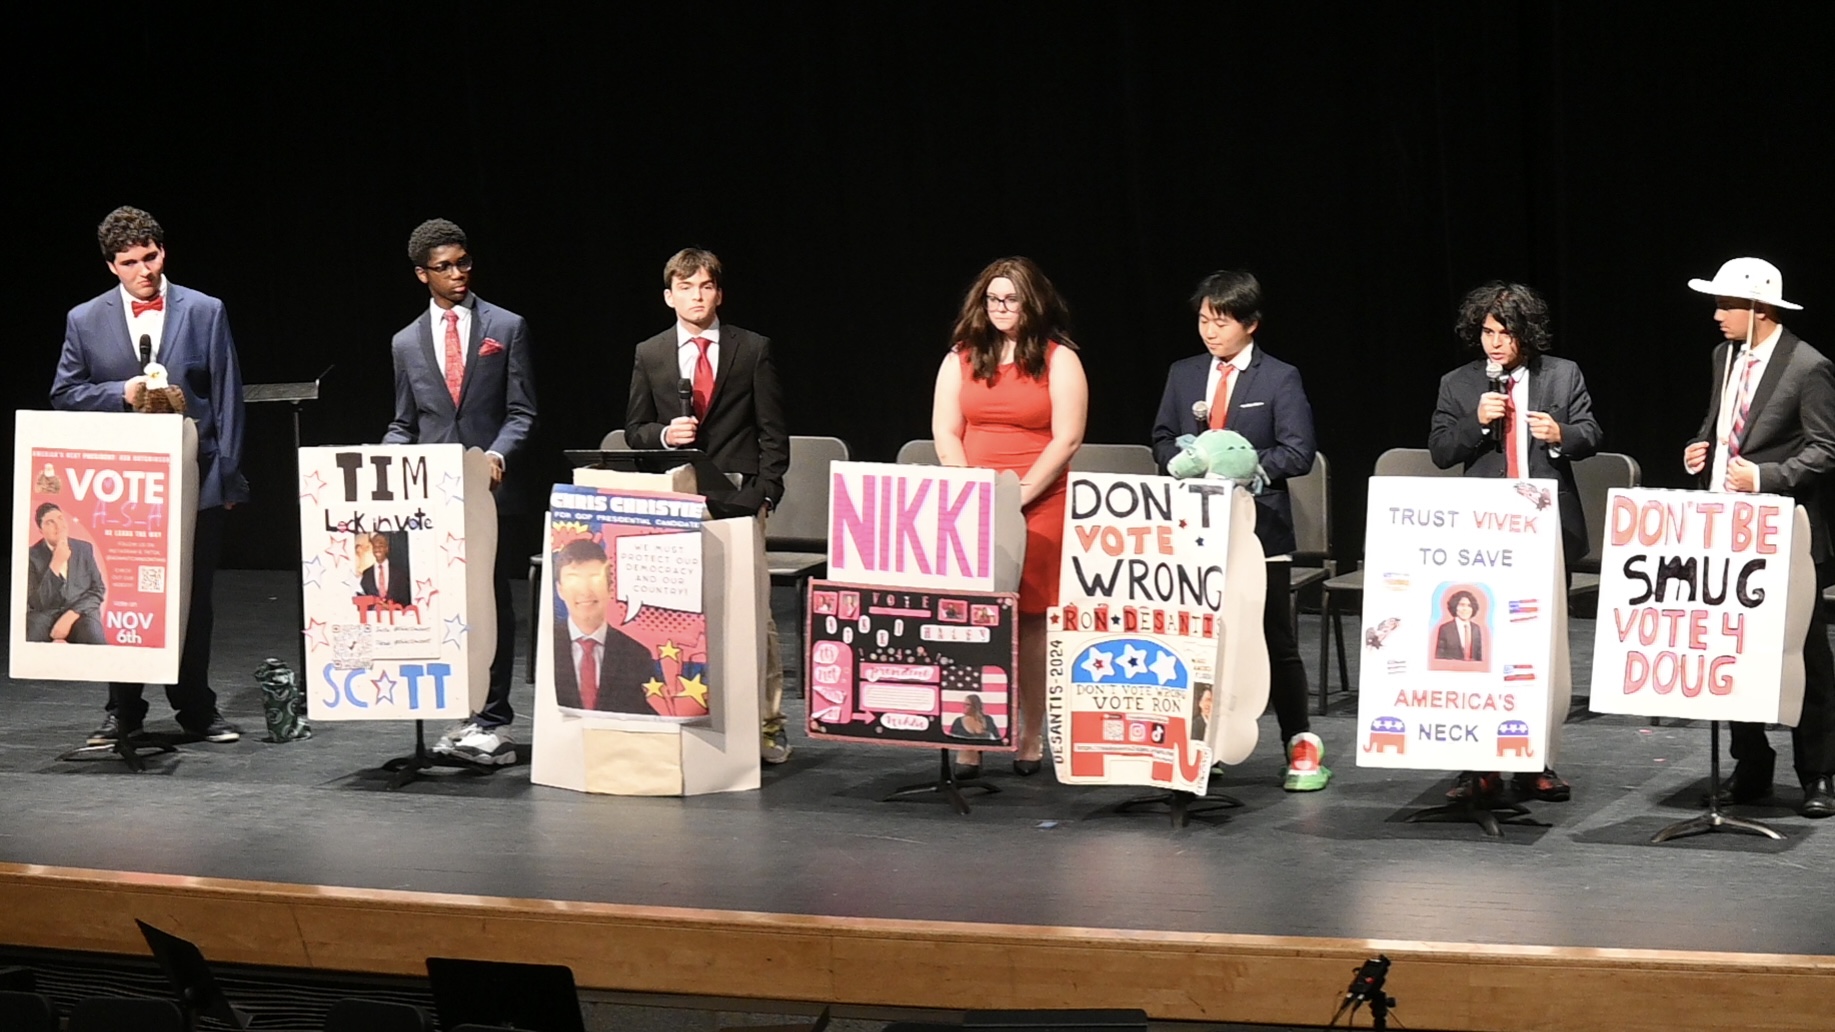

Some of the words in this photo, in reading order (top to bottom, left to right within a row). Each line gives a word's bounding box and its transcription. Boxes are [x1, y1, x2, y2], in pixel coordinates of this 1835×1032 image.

[65, 467, 164, 504] VOTE
[335, 452, 428, 502] TIM
[551, 492, 608, 511] CHRIS
[610, 496, 705, 518] CHRISTIE
[1071, 479, 1225, 528] DON'T
[554, 511, 571, 519] FOR
[596, 514, 651, 526] PRESIDENTIAL
[655, 519, 700, 529] CANDIDATE
[832, 473, 992, 578] NIKKI
[1389, 507, 1459, 528] TRUST
[1473, 510, 1538, 533] VIVEK
[1611, 495, 1724, 550] DON'T
[1731, 501, 1779, 555] BE
[655, 545, 684, 554] MUST
[1074, 525, 1174, 556] VOTE
[621, 553, 670, 563] PROTECT
[676, 557, 699, 565] OUR
[1419, 547, 1448, 566] TO
[1457, 548, 1514, 567] SAVE
[626, 563, 694, 575] DEMOCRACY
[636, 575, 657, 583] AND
[662, 576, 685, 584] OUR
[1071, 556, 1223, 612] WRONG
[1623, 554, 1767, 609] SMUG
[872, 591, 930, 609] VOTE
[107, 610, 154, 630] NOV
[1063, 609, 1109, 632] RON
[1614, 607, 1709, 650] VOTE
[1721, 612, 1745, 654] 4
[116, 629, 142, 644] 6th
[1623, 651, 1737, 698] DOUG
[1077, 684, 1117, 696] DON'T
[1121, 685, 1152, 696] VOTE
[1394, 689, 1516, 712] AMERICA'S
[1092, 695, 1144, 711] VOTE
[1152, 697, 1181, 713] RON
[1418, 723, 1479, 742] NECK
